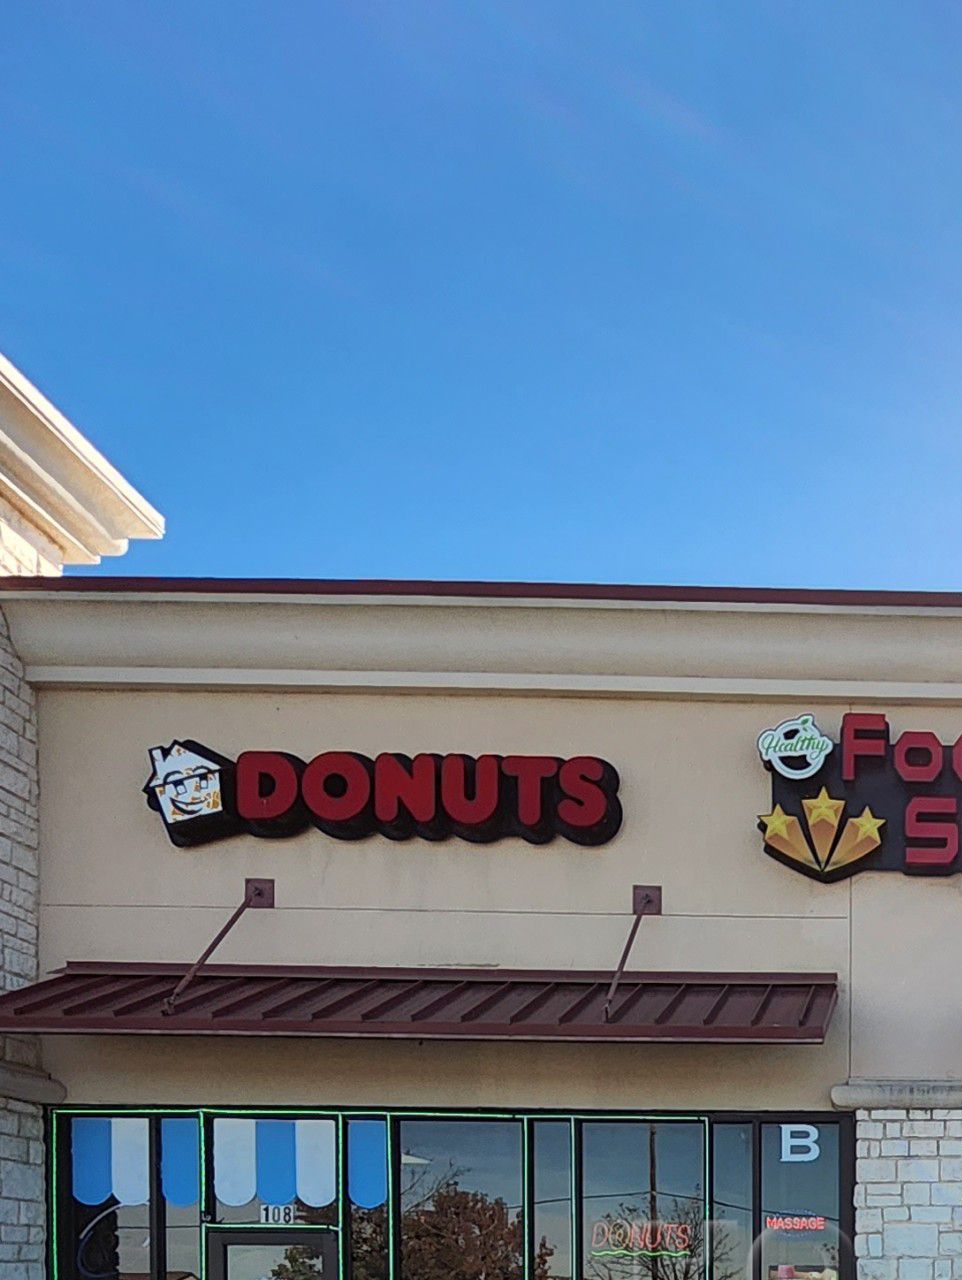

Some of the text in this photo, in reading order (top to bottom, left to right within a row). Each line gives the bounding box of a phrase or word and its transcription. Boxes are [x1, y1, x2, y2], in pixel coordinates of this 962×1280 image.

[762, 733, 830, 761] Healthy
[235, 750, 609, 828] DONUTS
[780, 1124, 820, 1162] B
[263, 1205, 292, 1223] 108
[766, 1217, 825, 1230] MASSAGE
[592, 1221, 690, 1249] DONUTS
